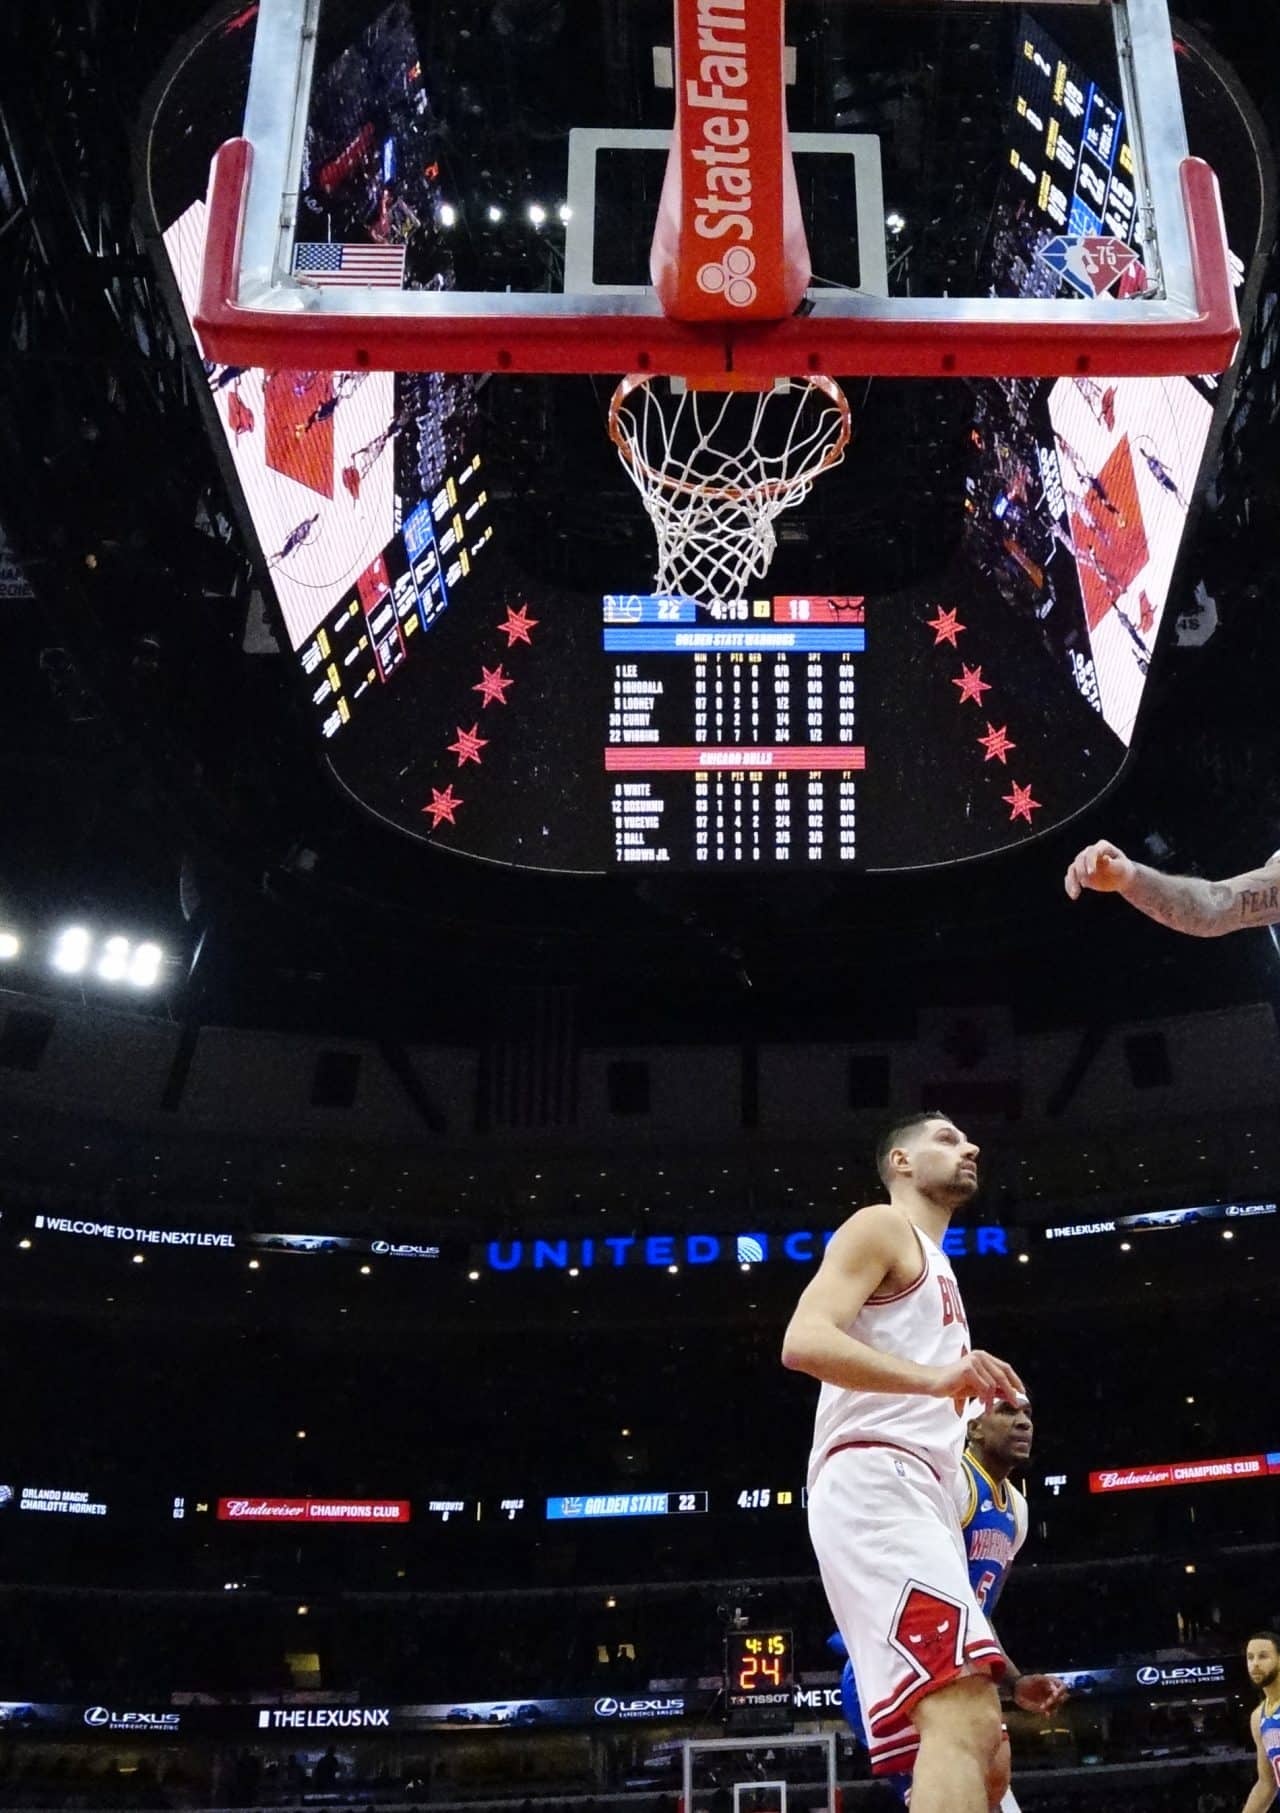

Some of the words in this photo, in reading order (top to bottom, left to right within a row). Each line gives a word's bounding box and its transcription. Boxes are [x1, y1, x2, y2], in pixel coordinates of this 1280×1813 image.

[1097, 245, 1115, 264] 75
[657, 600, 680, 620] 22
[710, 599, 748, 620] 4:15
[622, 665, 638, 678] LEE
[623, 783, 651, 796] WHITE
[1239, 885, 1279, 914] FEAR
[46, 1217, 115, 1238] WELCOME
[116, 1226, 135, 1240] TO
[135, 1229, 161, 1243] THE
[161, 1232, 197, 1245] NEXT
[197, 1233, 236, 1247] LEVEL
[1053, 1226, 1072, 1238] THE
[1071, 1223, 1101, 1236] LEXUS
[1099, 1221, 1115, 1232] NX
[390, 1244, 440, 1254] LEXUS
[488, 1234, 721, 1272] UNITED
[1099, 1470, 1170, 1489] Budweiser
[1174, 1463, 1232, 1480] CHAMPIONS
[1233, 1460, 1260, 1473] CLUB
[22, 1488, 61, 1501] ORLANDO
[61, 1491, 89, 1503] MAGIC
[584, 1496, 629, 1515] GOLDEN
[629, 1494, 666, 1513] STATE
[678, 1495, 696, 1511] 22
[736, 1489, 771, 1508] 4:15
[20, 1499, 68, 1513] CHARLOTTE
[68, 1502, 107, 1515] HORNETS
[227, 1500, 304, 1517] Budweiser
[310, 1504, 372, 1517] CHAMPIONS
[373, 1505, 400, 1518] CLUB
[745, 1635, 784, 1656] 4:15
[739, 1657, 780, 1690] 24
[1160, 1665, 1224, 1680] LEXUS
[619, 1699, 685, 1711] LEXUS
[749, 1693, 790, 1704] TISSOT
[111, 1712, 181, 1723] LEXUS
[273, 1710, 307, 1728] THE
[307, 1710, 362, 1727] LEXUS
[363, 1709, 390, 1726] NX
